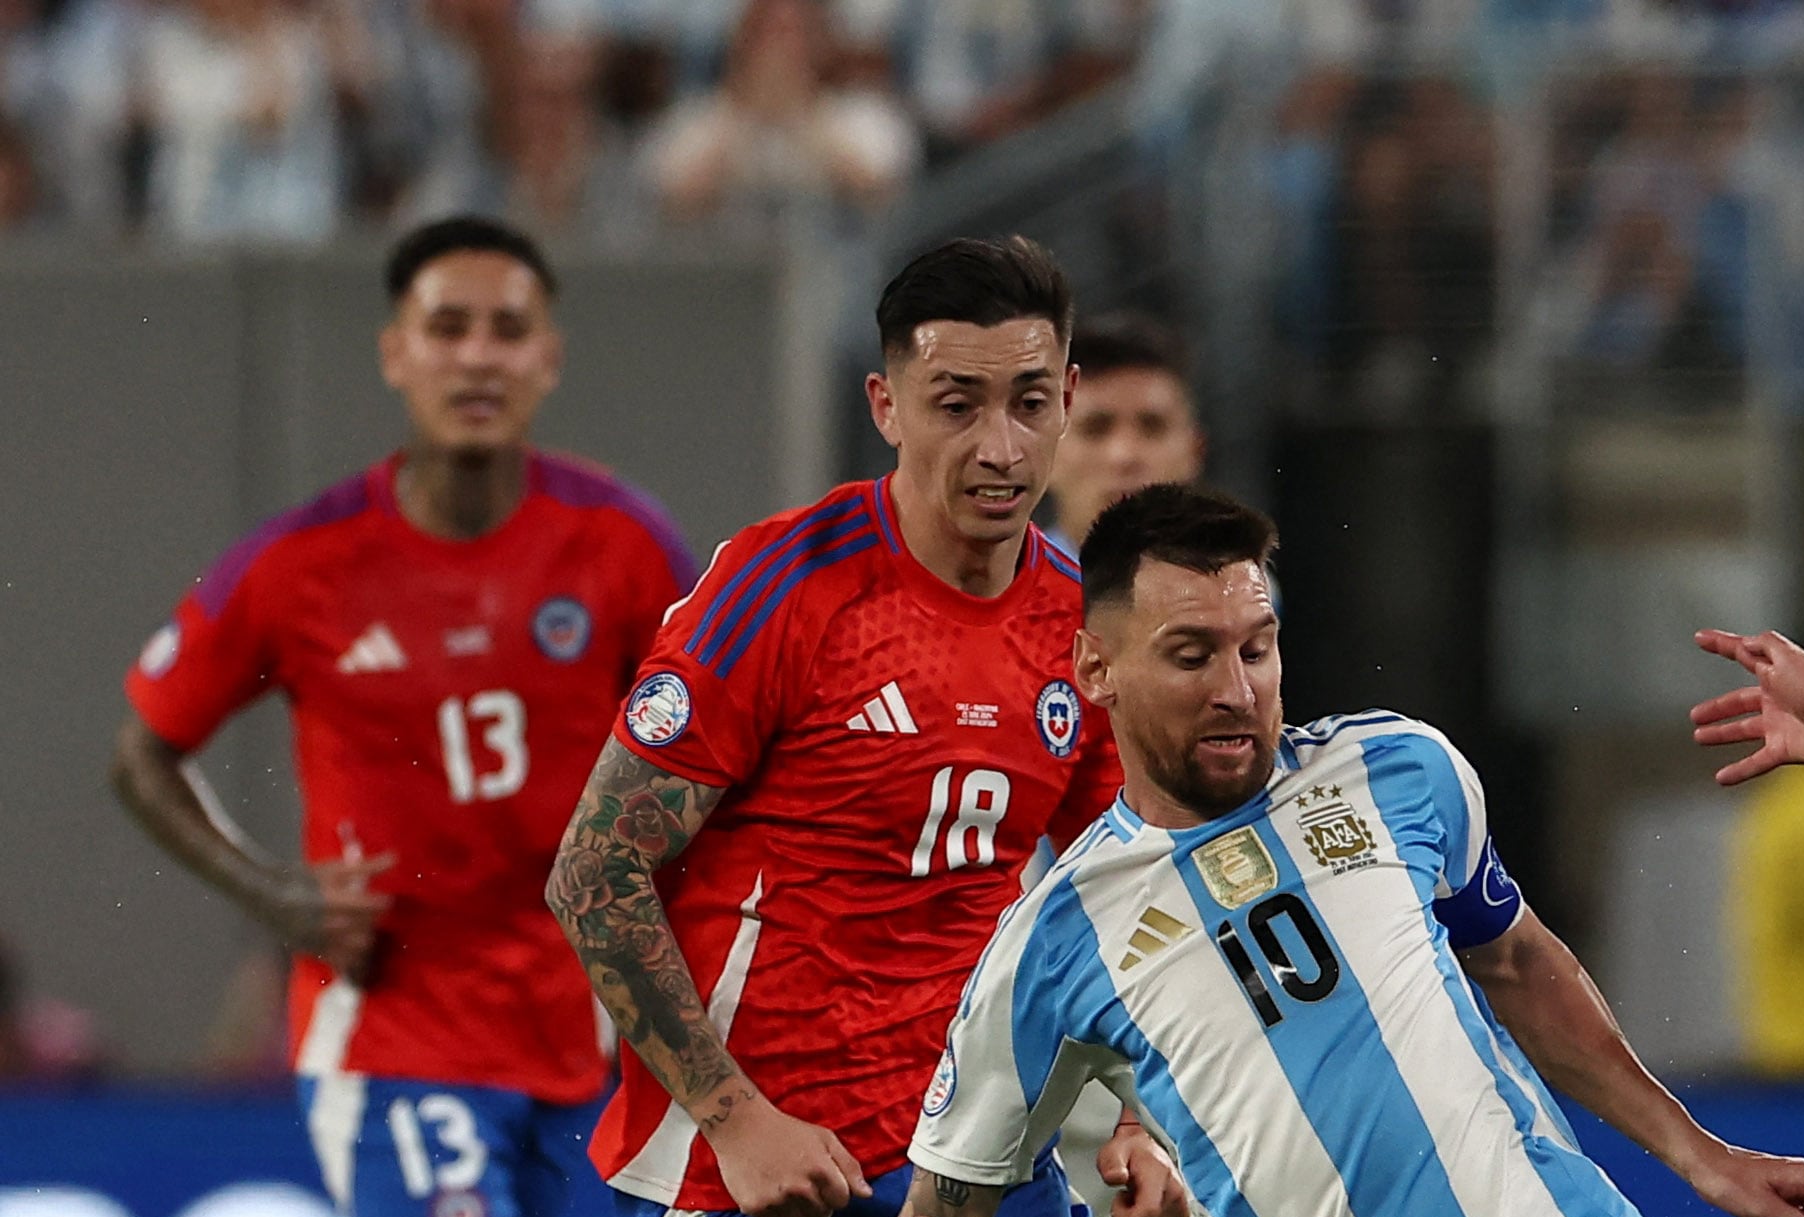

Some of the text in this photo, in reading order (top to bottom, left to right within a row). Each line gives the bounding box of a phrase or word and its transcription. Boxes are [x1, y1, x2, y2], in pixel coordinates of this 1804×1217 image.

[437, 691, 528, 802] 13
[911, 766, 1011, 877] 18
[1317, 818, 1362, 850] AFA
[1217, 891, 1341, 1028] 10
[389, 1094, 487, 1196] 13
